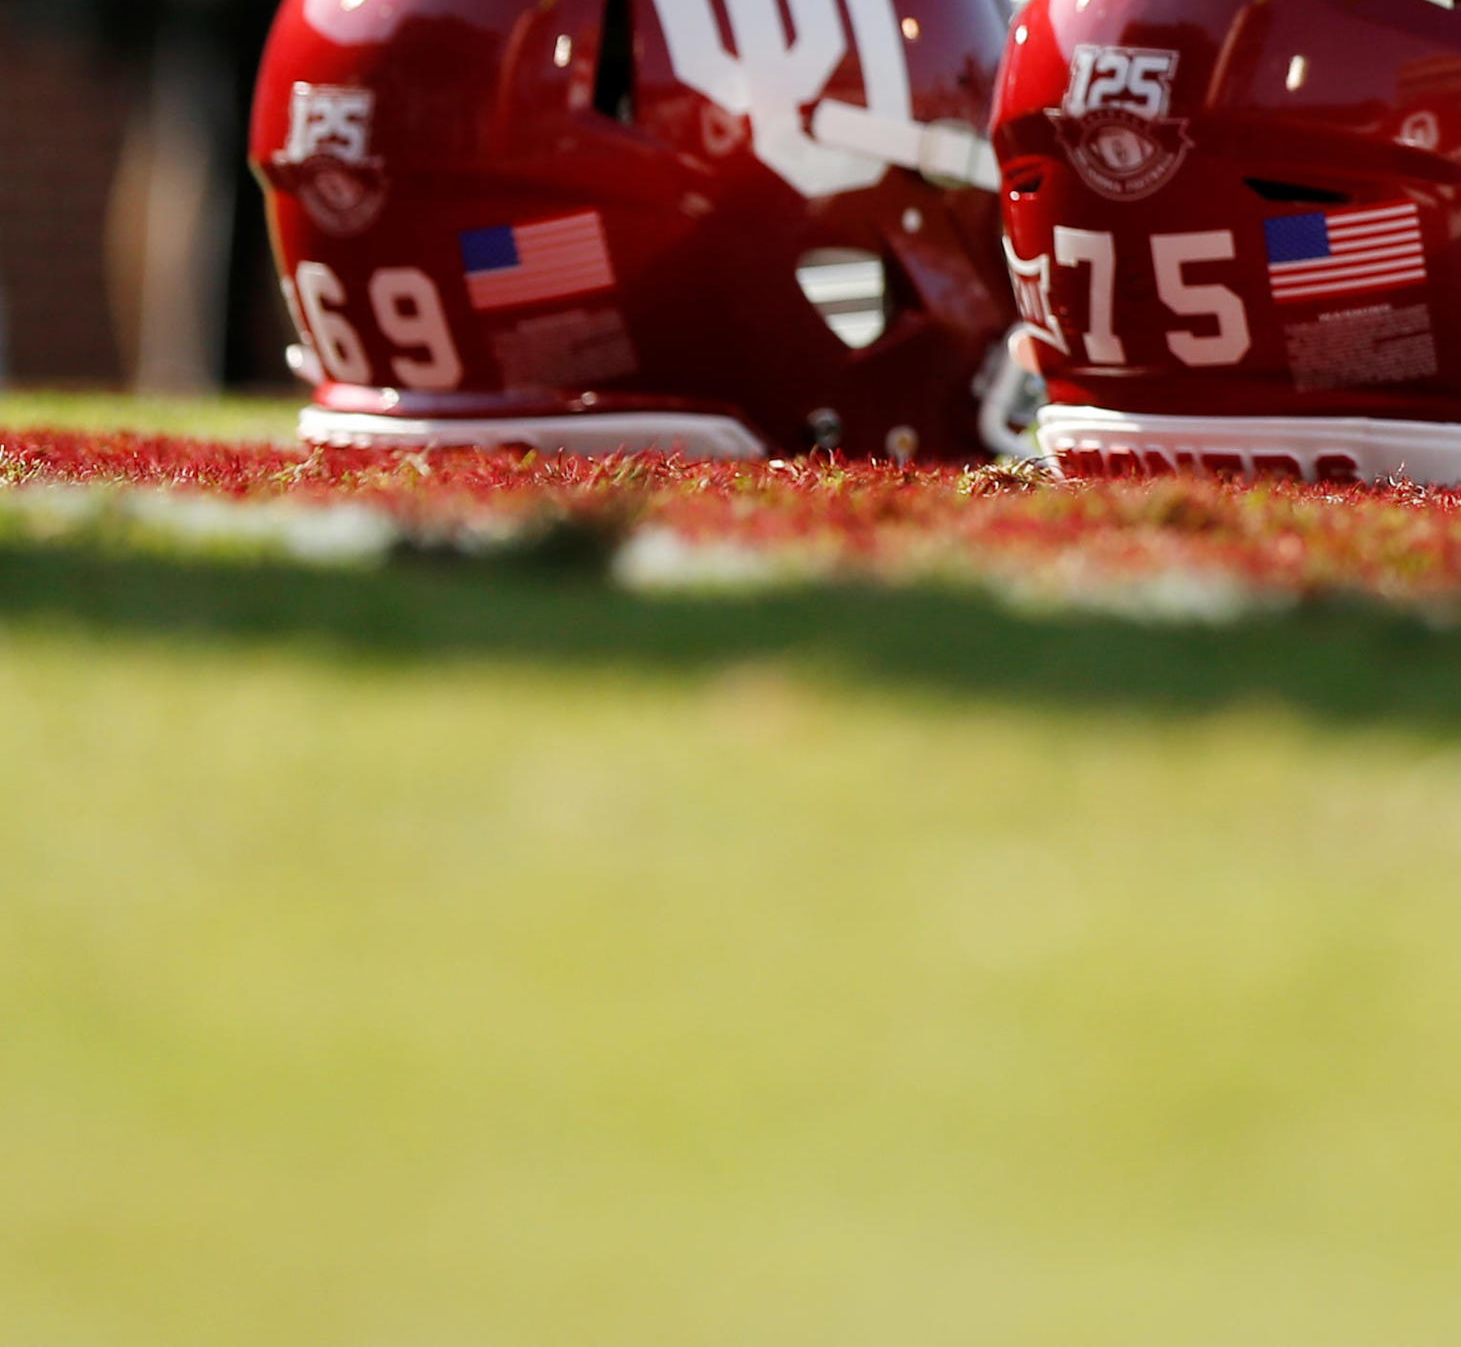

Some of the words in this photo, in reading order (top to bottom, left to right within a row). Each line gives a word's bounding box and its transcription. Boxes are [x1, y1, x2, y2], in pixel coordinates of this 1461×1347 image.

[286, 81, 375, 164] 125
[1063, 44, 1180, 120] 125
[295, 260, 463, 390] 69
[1053, 224, 1252, 367] 75
